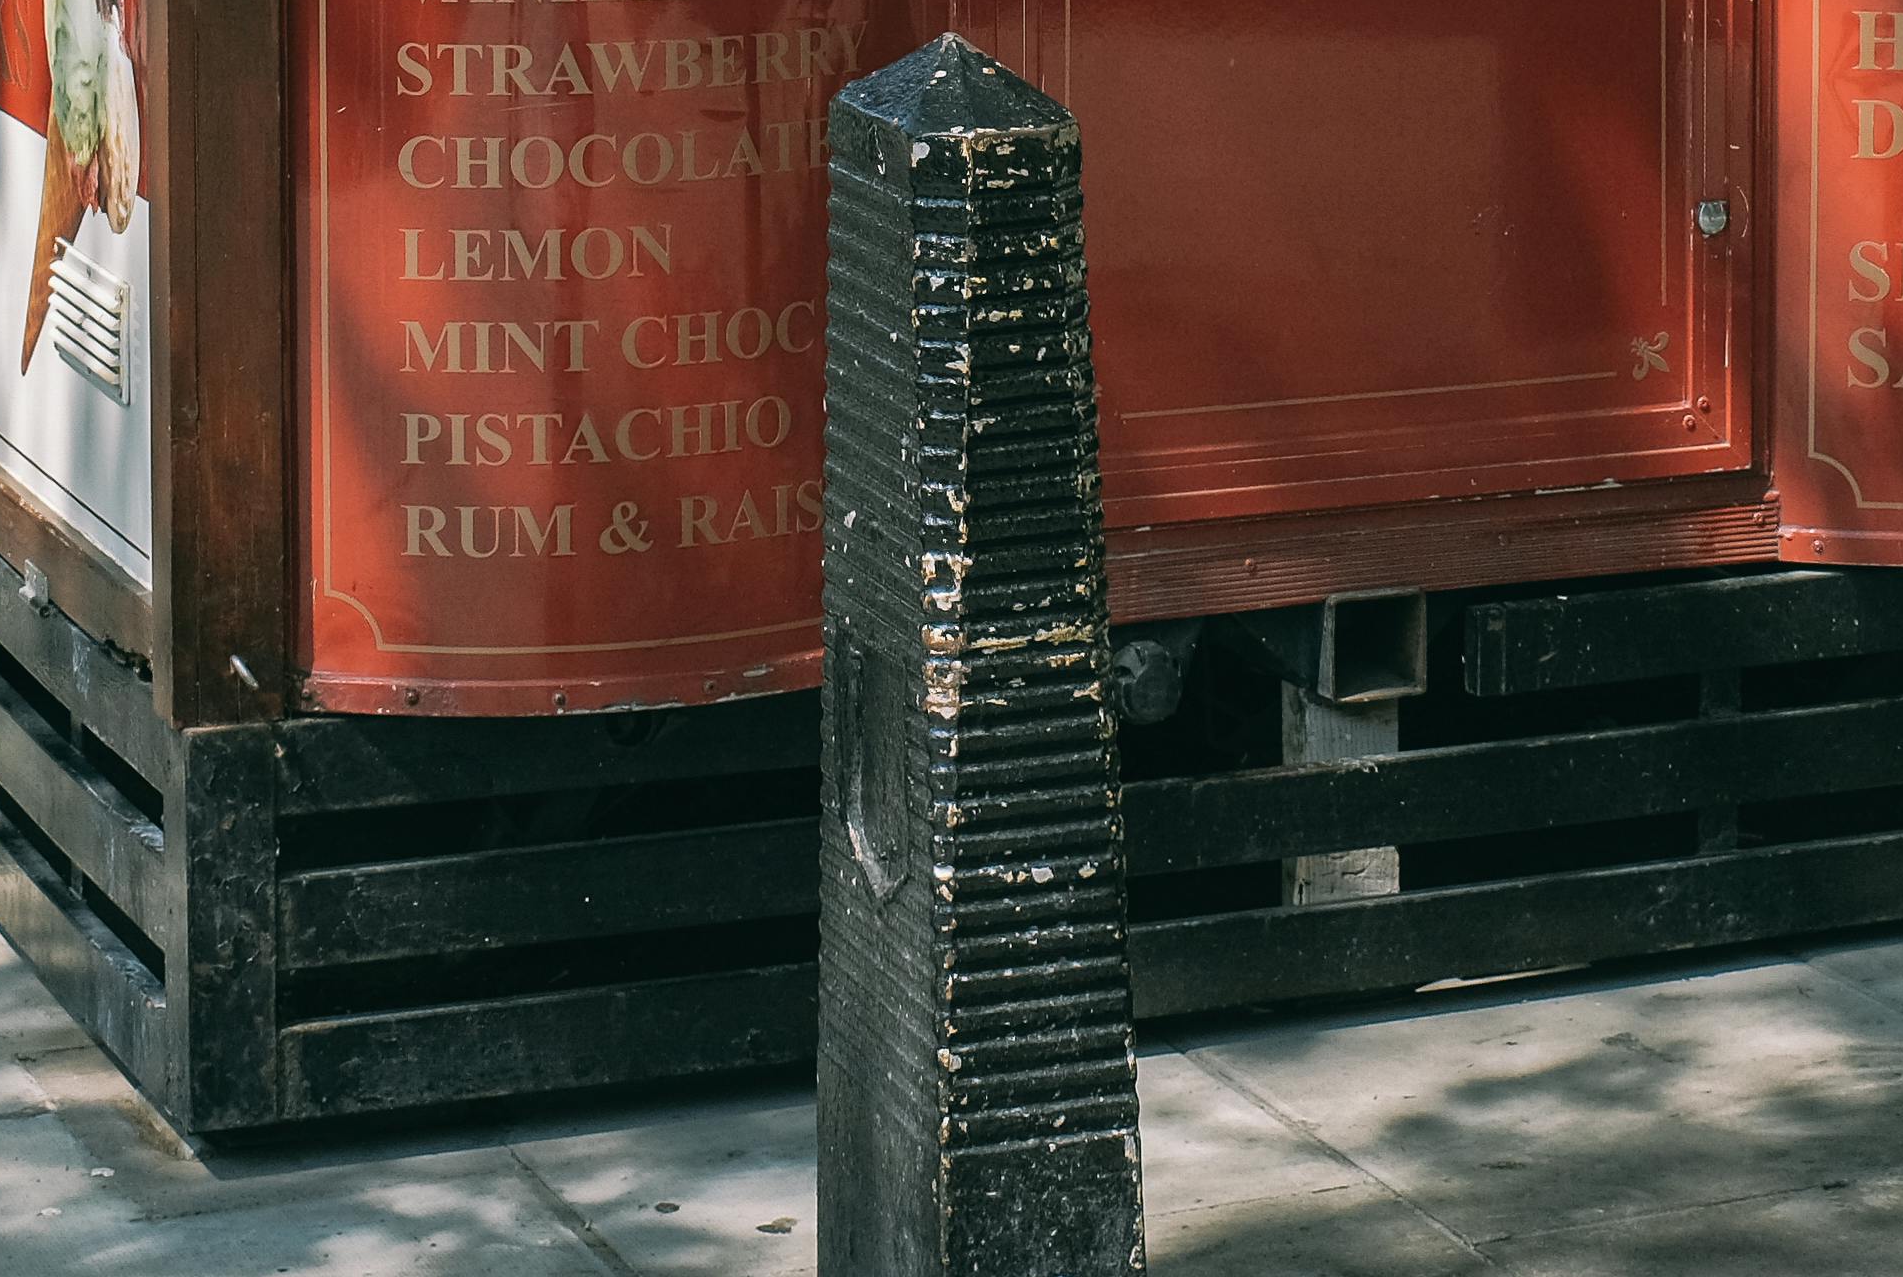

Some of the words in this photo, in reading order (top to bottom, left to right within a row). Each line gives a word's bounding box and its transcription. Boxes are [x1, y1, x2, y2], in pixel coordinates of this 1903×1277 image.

[398, 20, 867, 98] STRAWBERRY
[399, 223, 674, 282] LEMON
[399, 319, 600, 374] MINT
[621, 299, 816, 370] CHOC
[400, 395, 793, 467] PISTACHIO
[401, 502, 578, 559] RUM
[598, 499, 654, 556] &
[676, 479, 825, 550] RAIS
